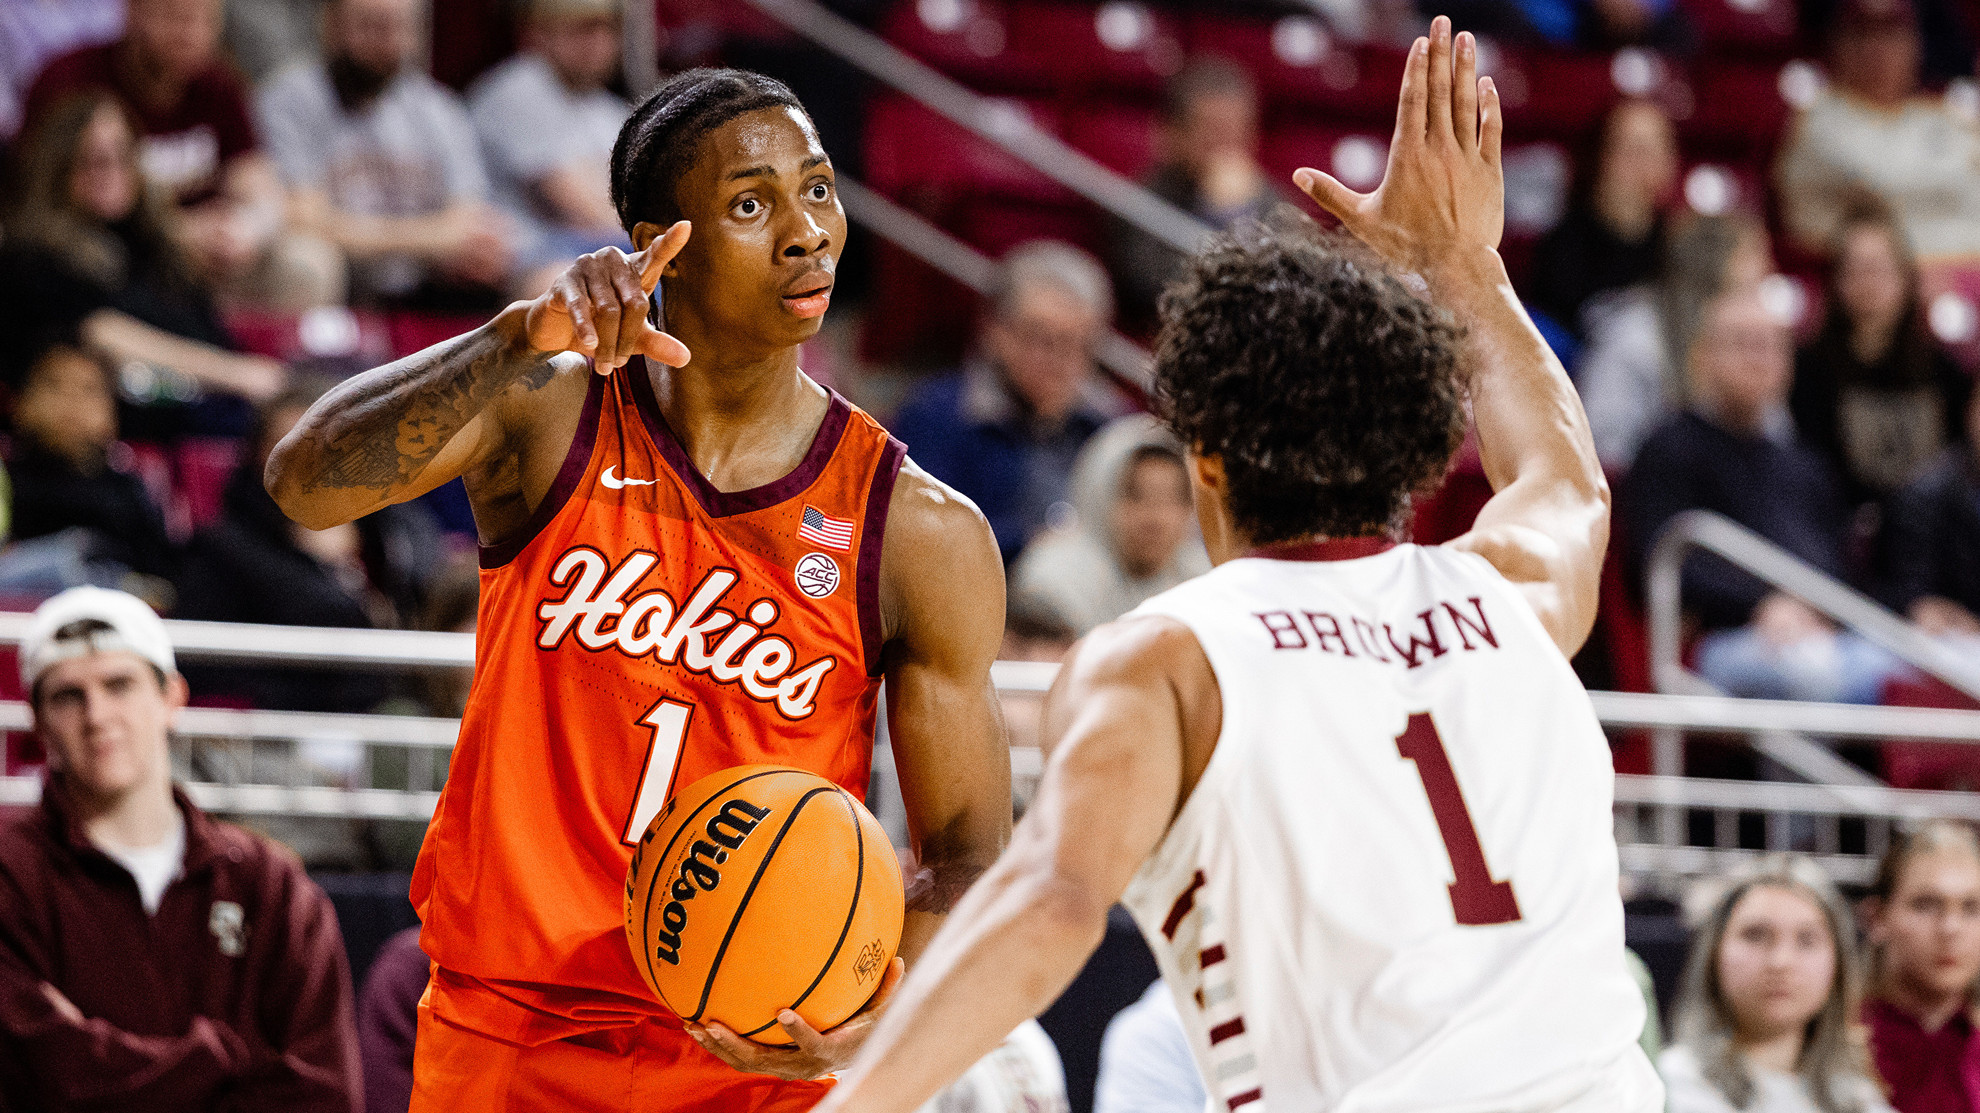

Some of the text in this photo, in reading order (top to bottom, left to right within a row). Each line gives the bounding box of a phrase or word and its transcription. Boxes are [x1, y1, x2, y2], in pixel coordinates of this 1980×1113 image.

[538, 545, 837, 720] Hokies
[802, 567, 837, 582] ACC
[1251, 597, 1501, 669] BROWN
[621, 697, 695, 847] 1
[677, 830, 697, 861] INDOOR
[1394, 711, 1522, 925] 1
[657, 799, 773, 966] Wilson
